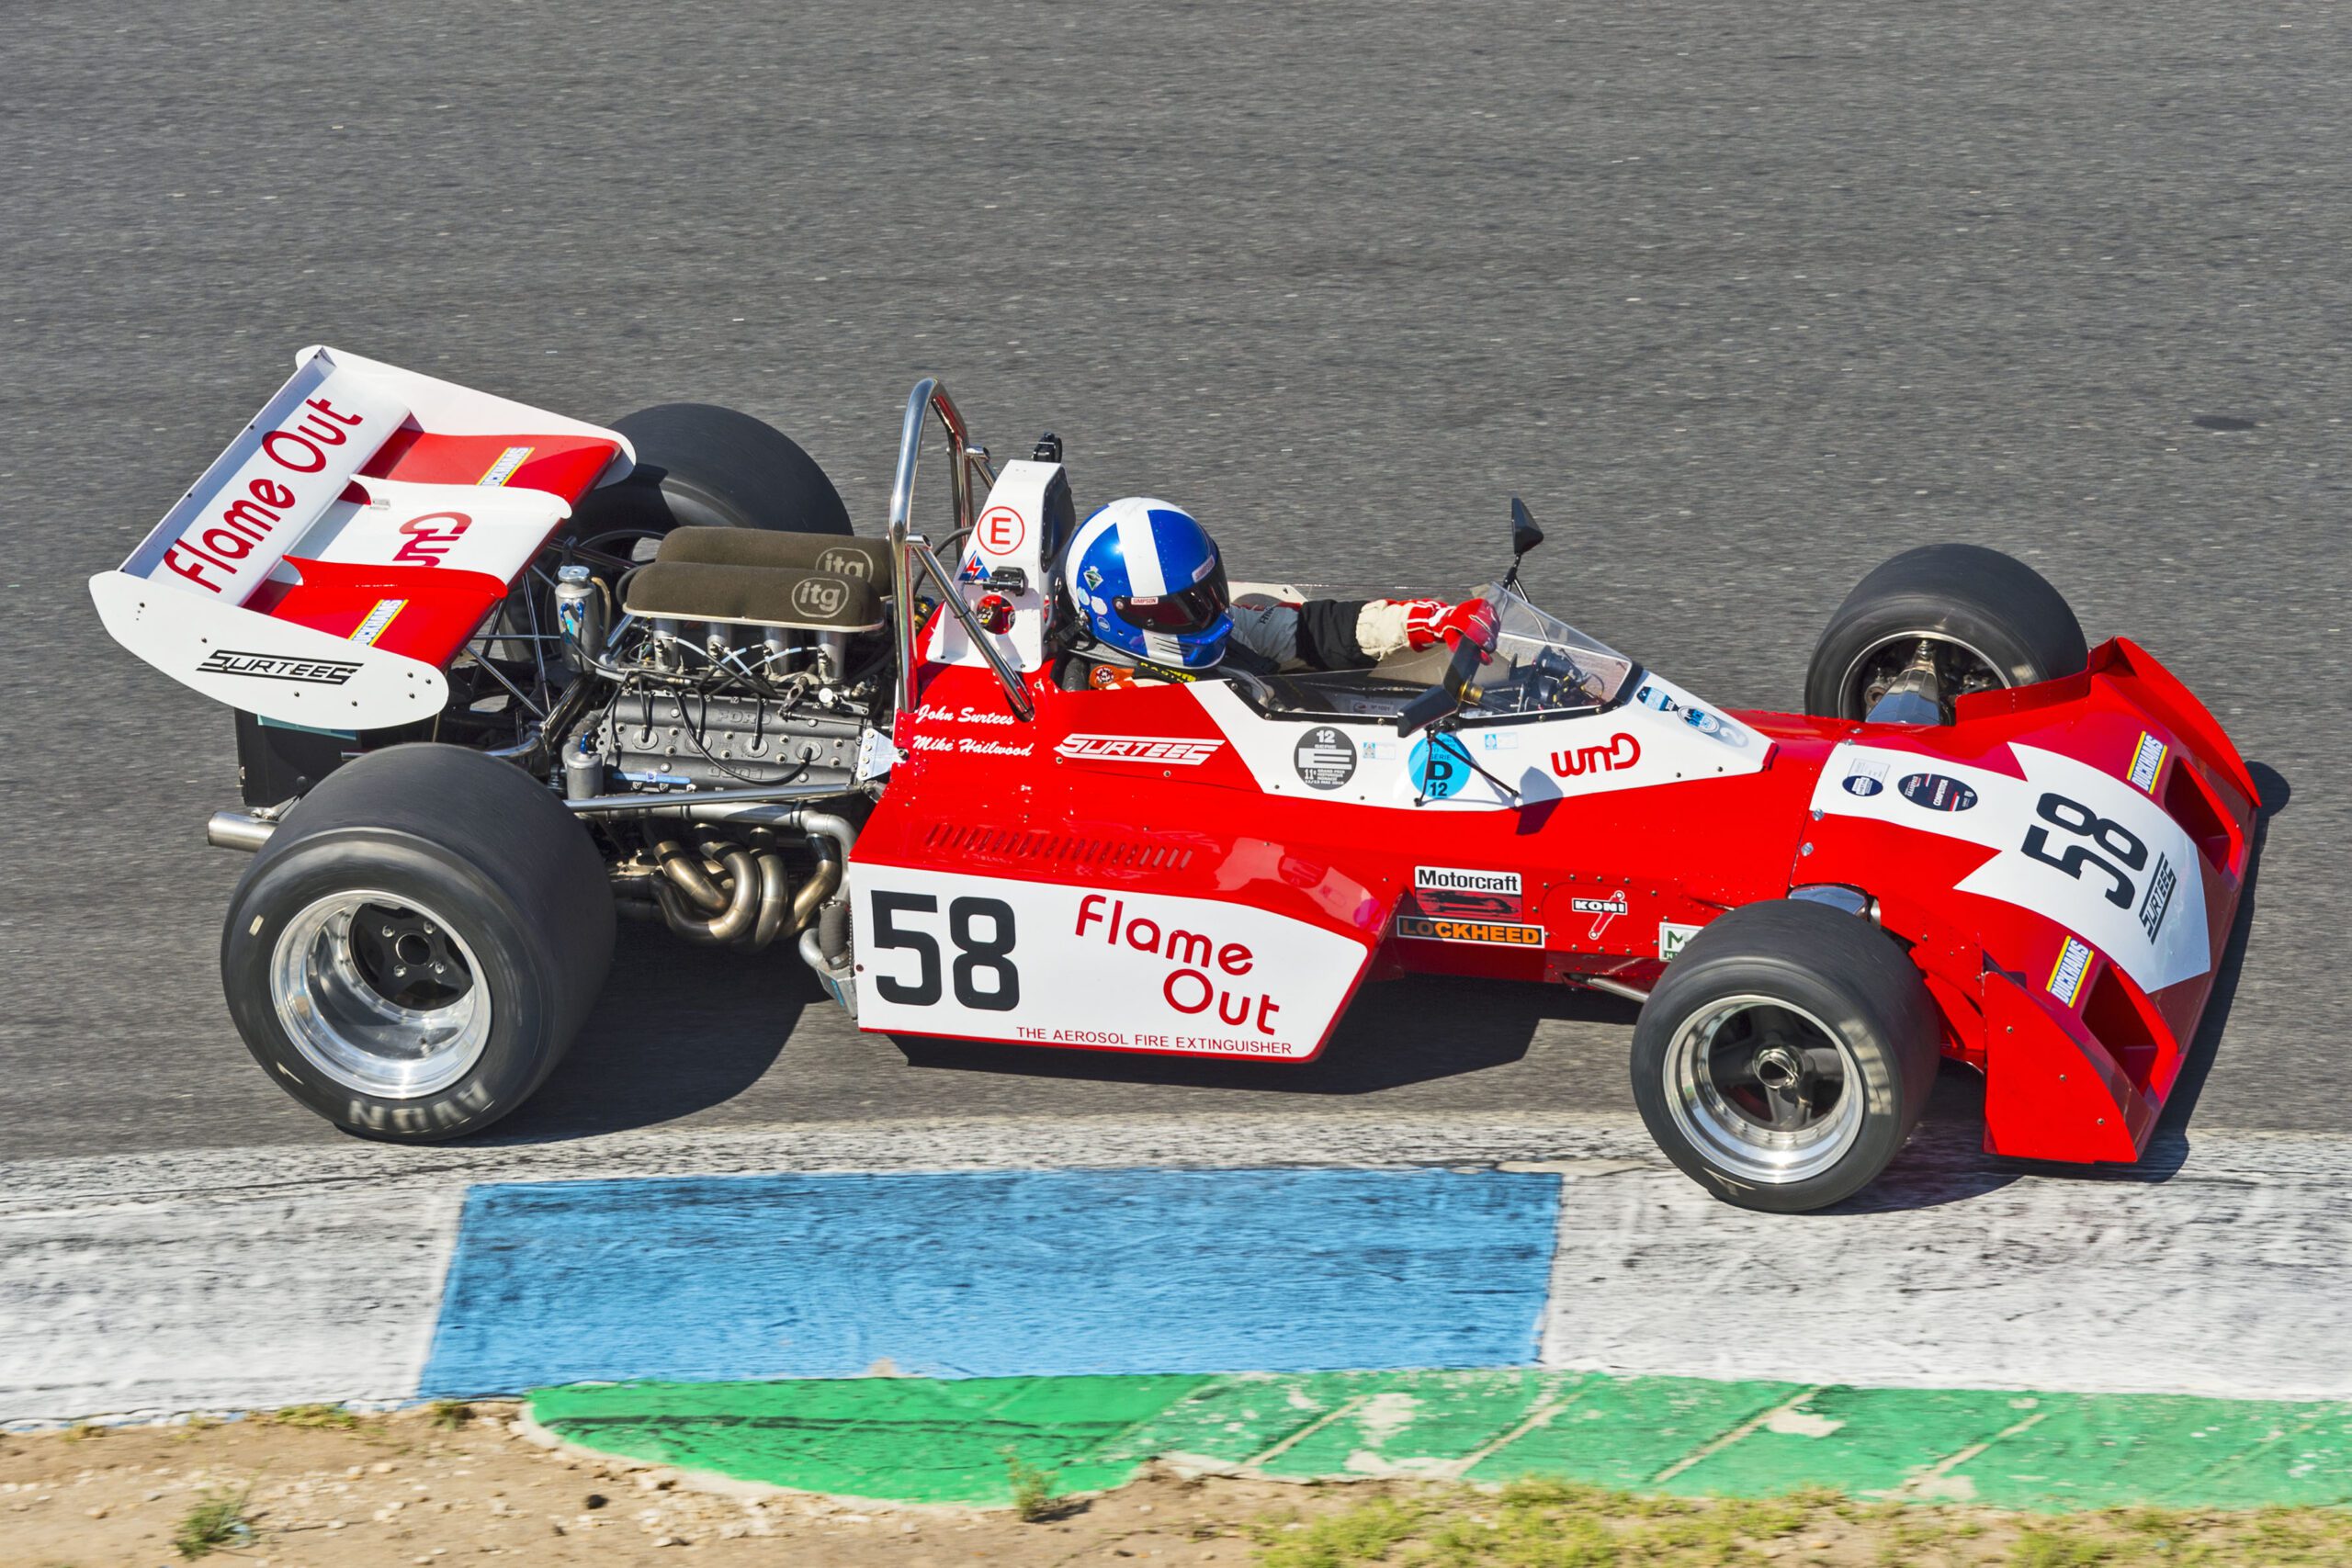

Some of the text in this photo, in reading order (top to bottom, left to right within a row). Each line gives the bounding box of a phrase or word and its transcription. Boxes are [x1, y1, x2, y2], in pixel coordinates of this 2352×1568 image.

[163, 399, 363, 593] Flame Out
[990, 516, 1011, 545] E
[799, 581, 841, 612] itg
[197, 649, 364, 685] SURTEES
[916, 704, 1015, 726] John Surtees
[912, 735, 1035, 757] Mike Hailwood
[1054, 733, 1226, 765] SURTEES
[1317, 729, 1336, 743] 12
[1298, 747, 1352, 770] E
[1427, 761, 1453, 780] D
[2131, 734, 2165, 792] DUCKHAMS
[1430, 782, 1448, 797] 12
[2021, 793, 2148, 909] 58
[1419, 868, 1518, 892] Motorcraft
[1574, 900, 1626, 913] KONI
[2139, 851, 2177, 945] SURTEES
[1076, 894, 1253, 976] Flame
[1402, 918, 1540, 944] LOCKHEED
[871, 890, 1020, 1011] 58
[2050, 938, 2090, 1005] DUCKHAMS
[1163, 968, 1280, 1036] Out
[1016, 1027, 1293, 1055] THE AEROSOL FIRE EXTINGUISHER
